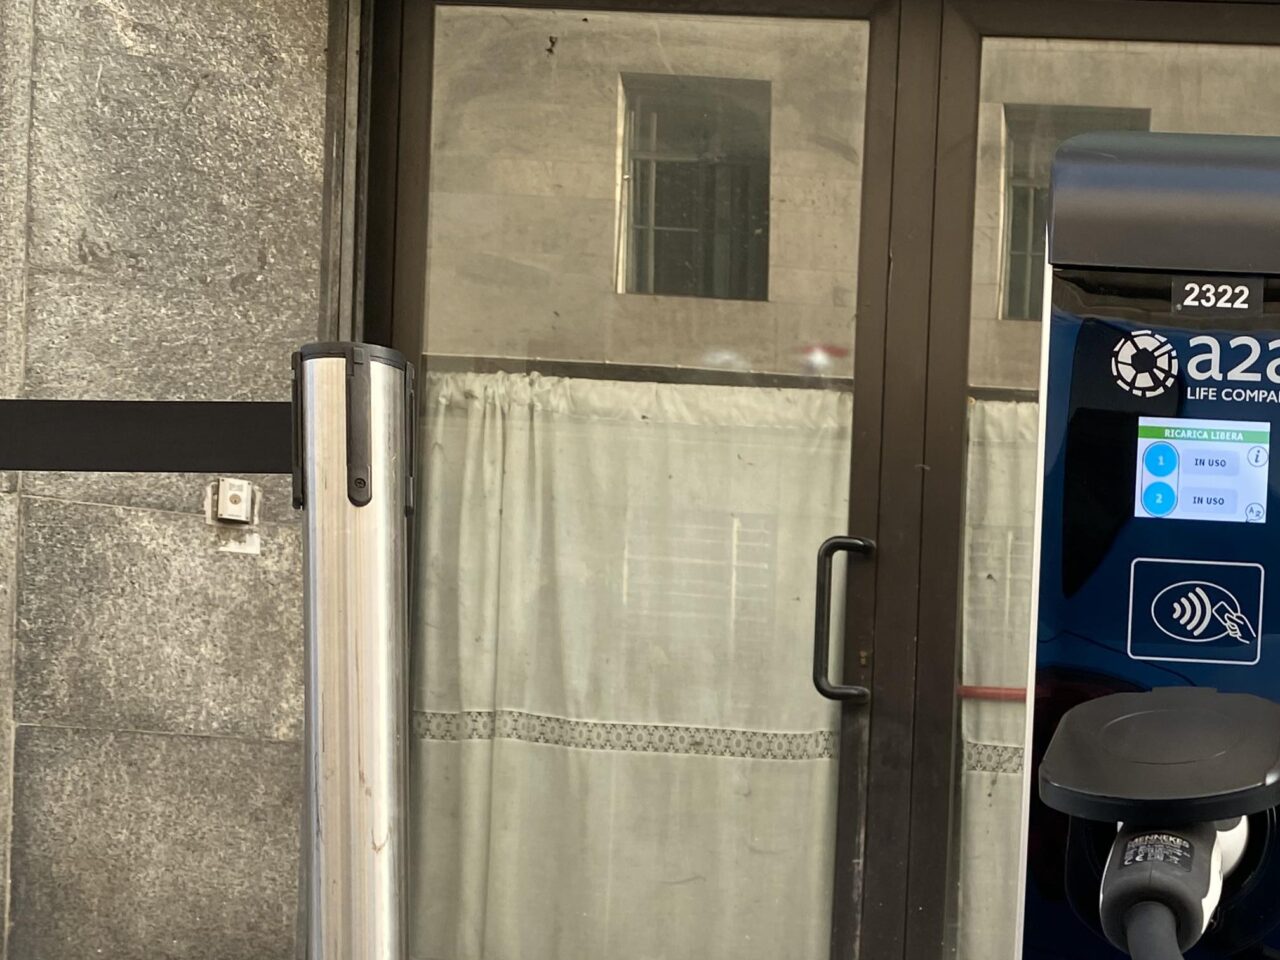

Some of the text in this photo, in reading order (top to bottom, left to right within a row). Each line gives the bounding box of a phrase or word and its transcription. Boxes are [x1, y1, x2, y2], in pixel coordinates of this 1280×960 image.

[1183, 283, 1250, 309] 2322
[1187, 387, 1217, 400] LIFE
[1164, 429, 1244, 441] RICARICA LIBERA
[1157, 455, 1165, 466] 1
[1194, 458, 1227, 468] IN USO
[1155, 493, 1163, 504] 2
[1192, 496, 1225, 506] IN USO
